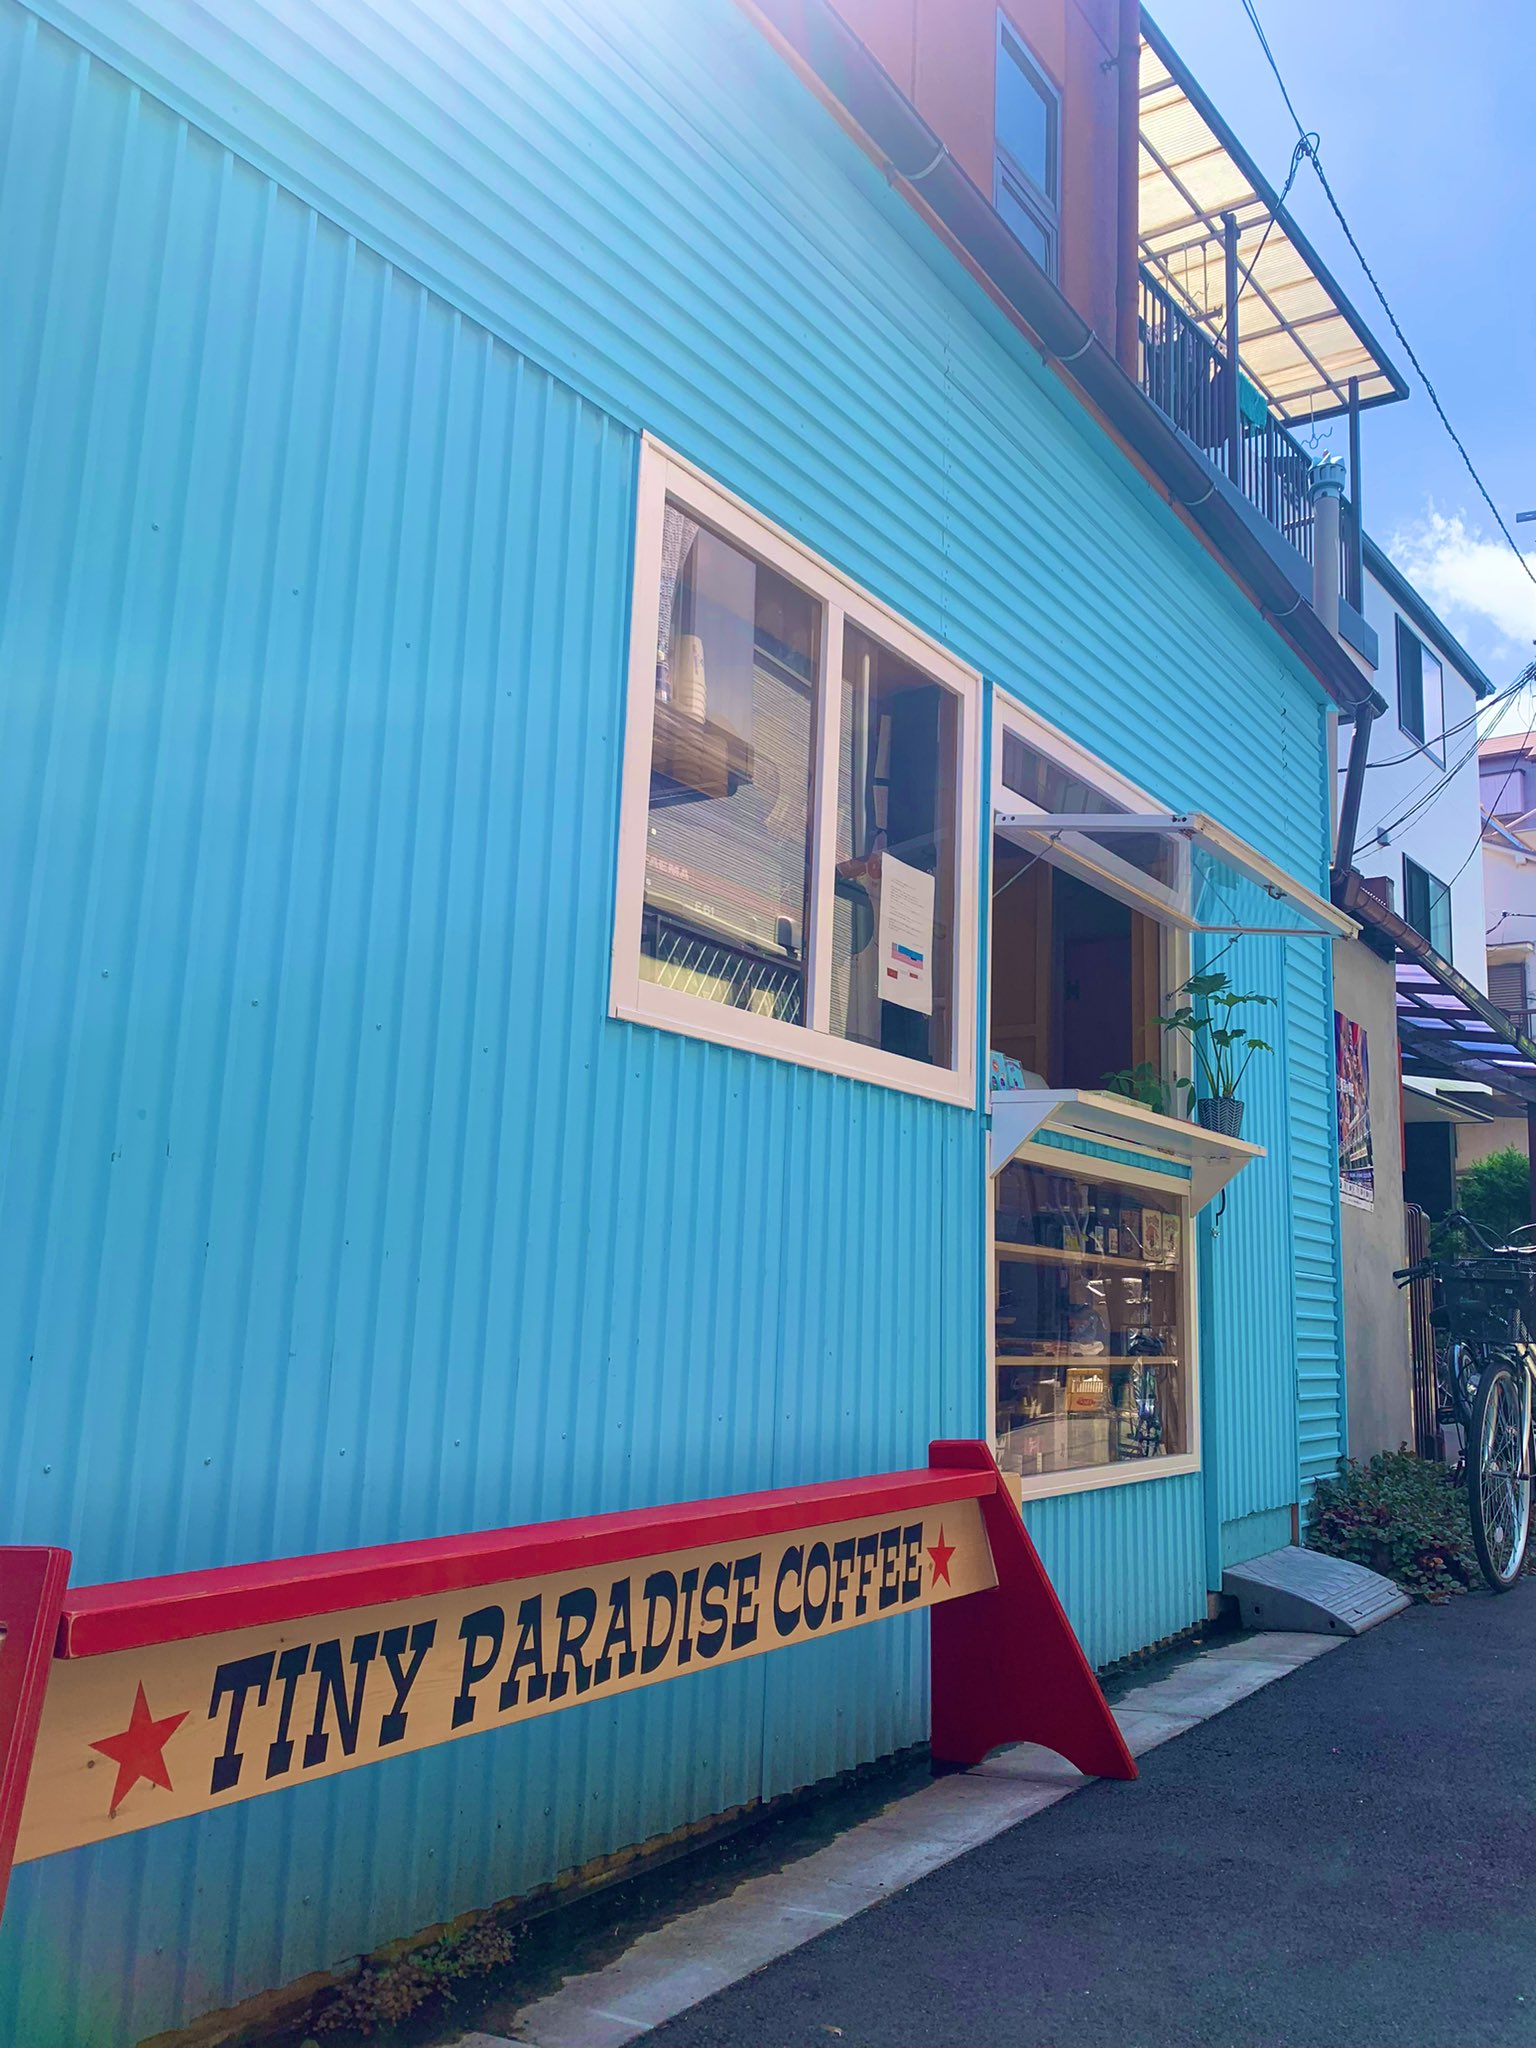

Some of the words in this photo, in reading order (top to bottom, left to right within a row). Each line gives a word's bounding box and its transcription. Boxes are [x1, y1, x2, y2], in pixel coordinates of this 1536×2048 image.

[208, 1619, 437, 1795] TINY
[452, 1552, 761, 1730] PARADISE
[774, 1522, 923, 1636] COFFEE
